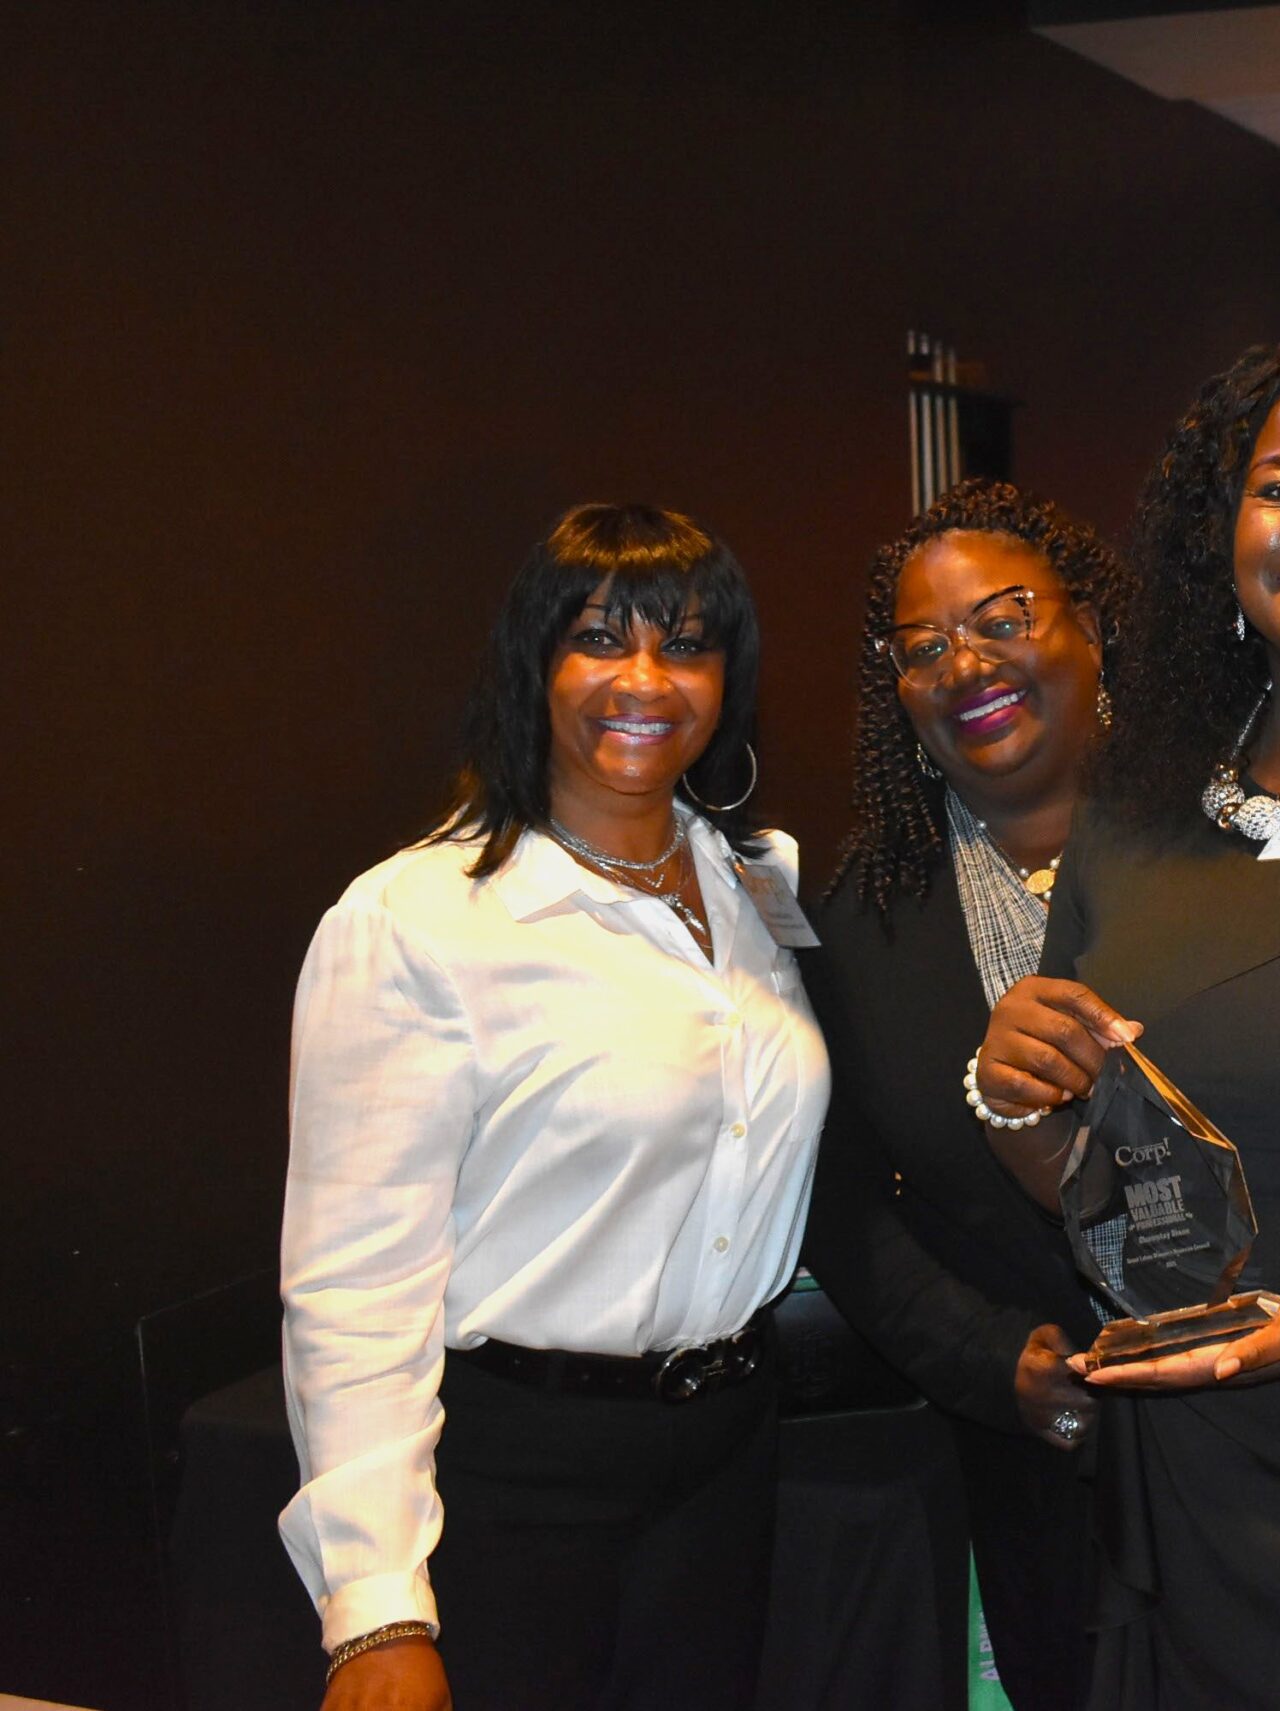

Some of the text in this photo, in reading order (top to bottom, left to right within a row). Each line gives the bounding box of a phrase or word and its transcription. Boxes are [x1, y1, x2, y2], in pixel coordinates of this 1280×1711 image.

[1115, 1137, 1171, 1167] Corp!
[1124, 1175, 1181, 1209] MOST
[1130, 1199, 1184, 1222] VALUABLE
